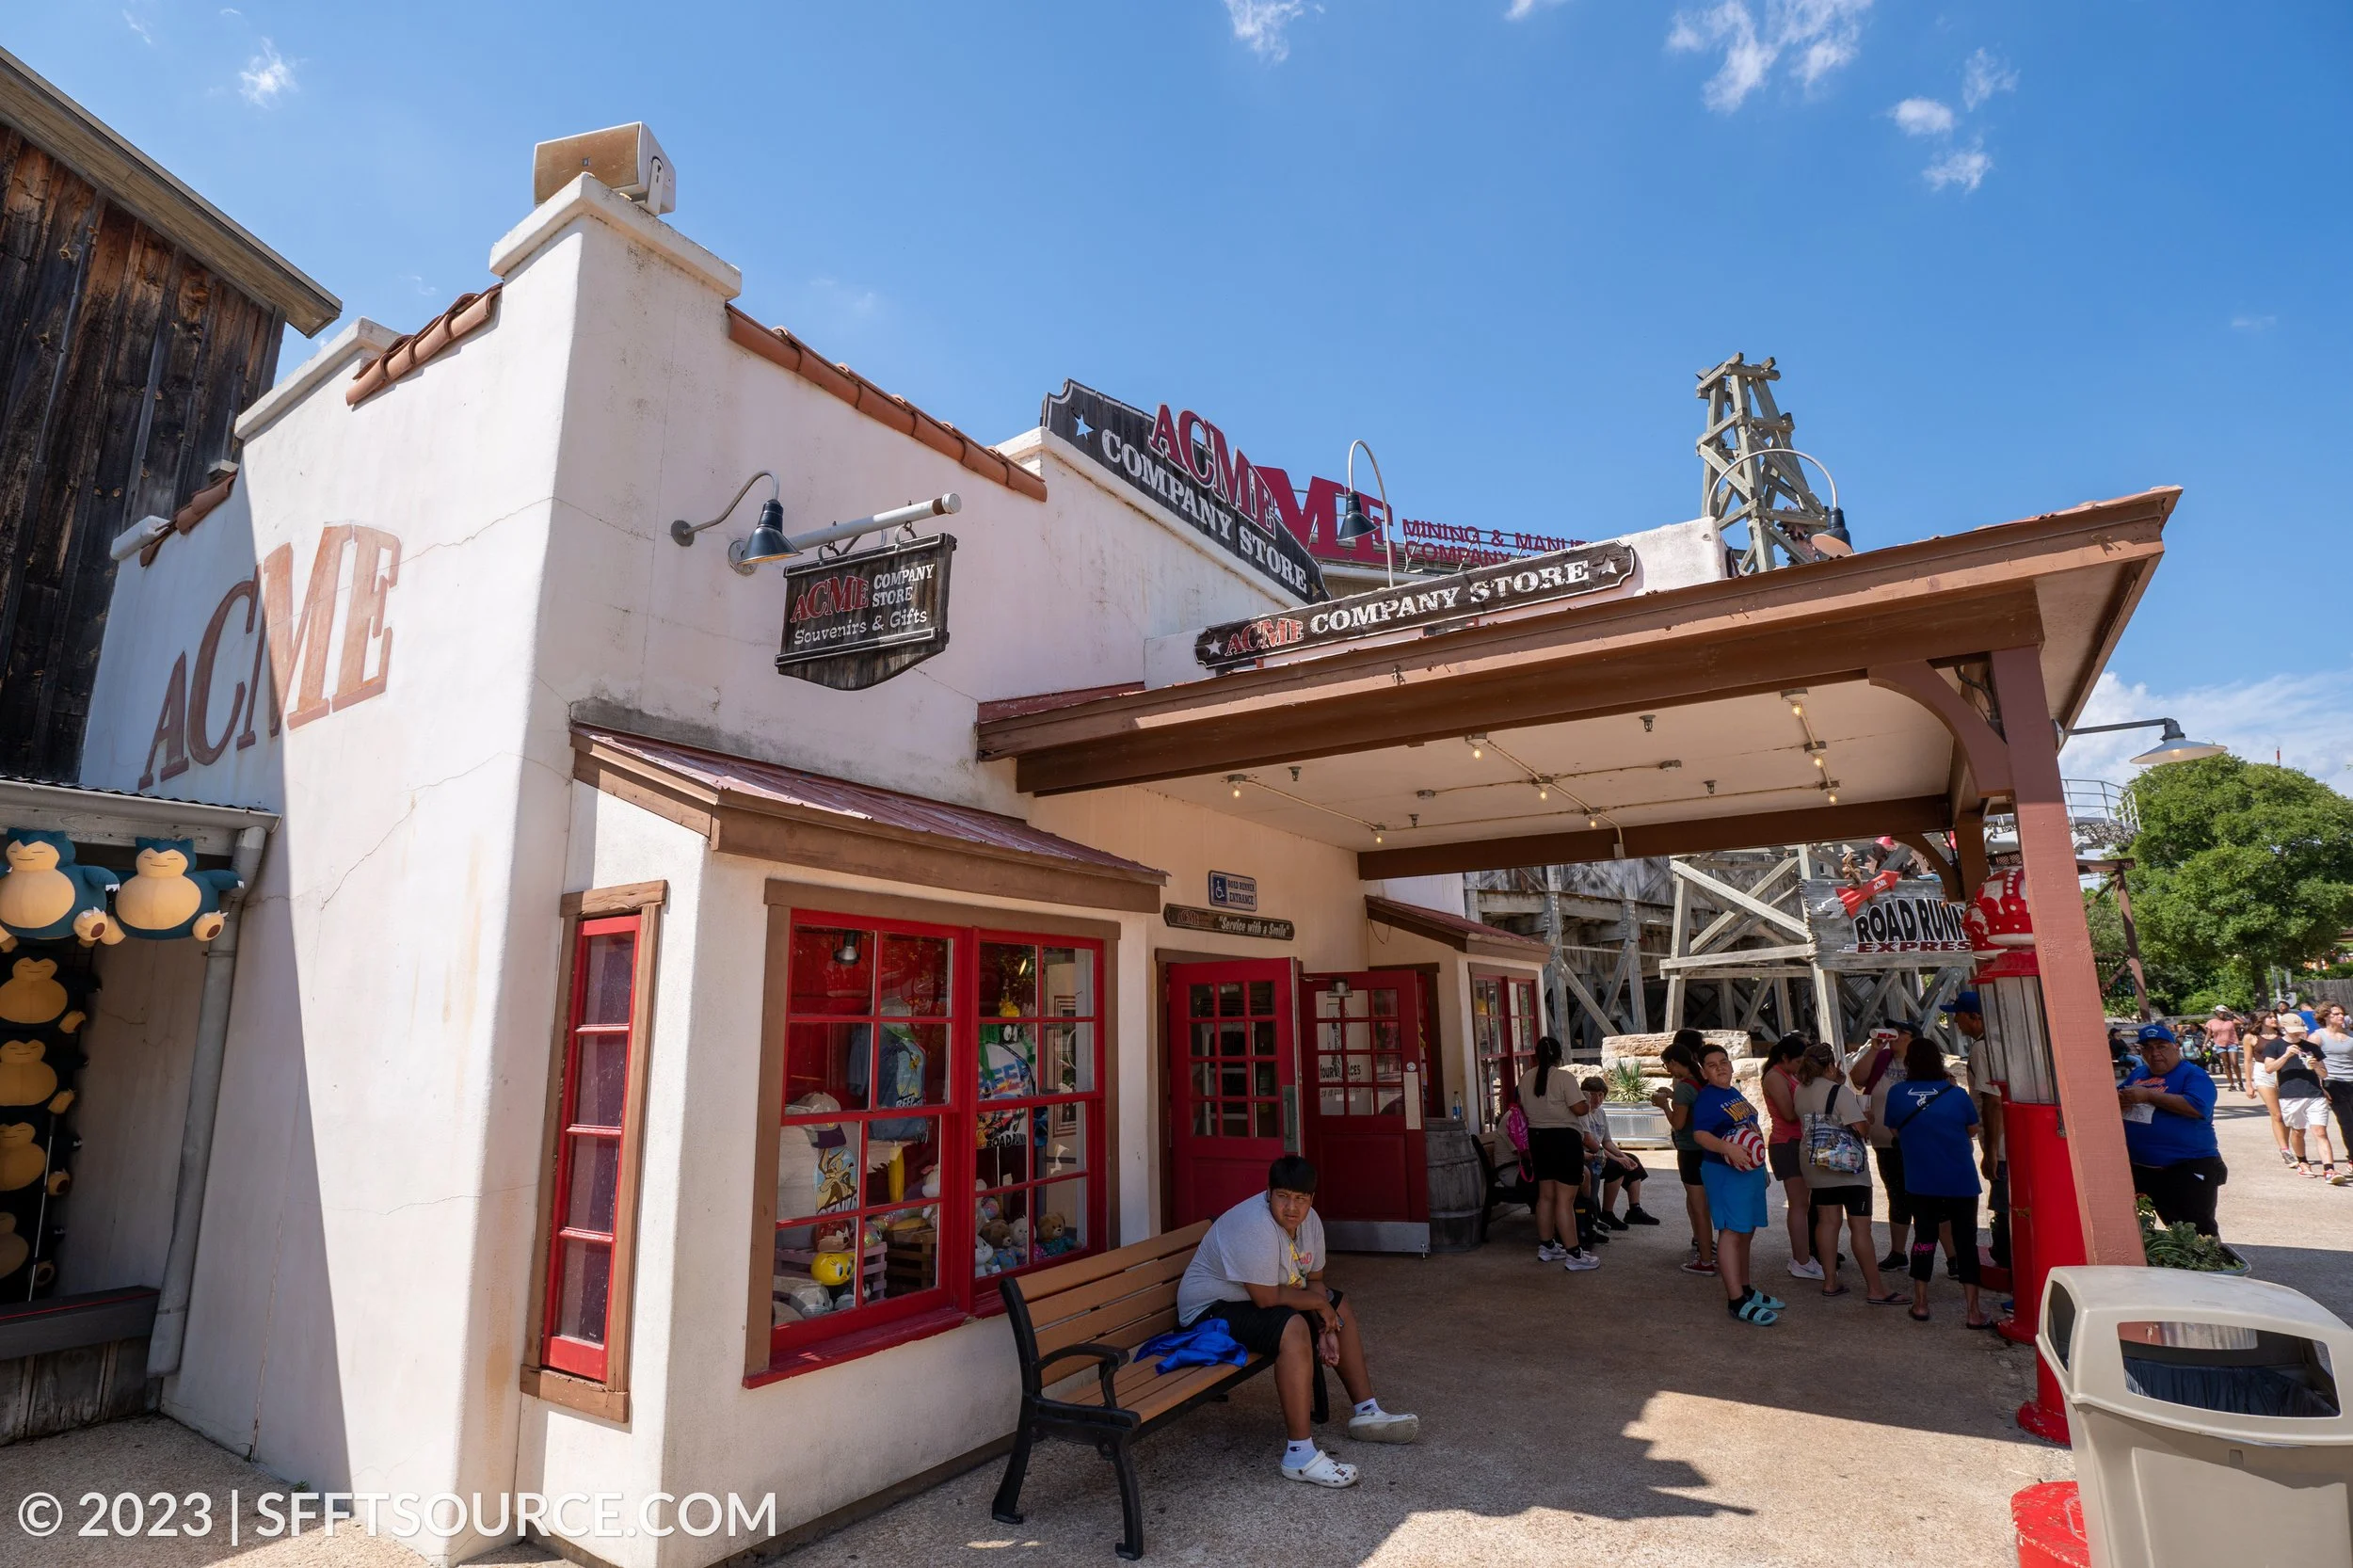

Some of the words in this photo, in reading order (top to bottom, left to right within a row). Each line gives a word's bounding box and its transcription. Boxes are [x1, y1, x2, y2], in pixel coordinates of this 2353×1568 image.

[1147, 402, 1277, 539] ACME
[1101, 428, 1233, 541] COMPANY
[1240, 528, 1308, 594] STORE
[1401, 519, 1480, 544] MINING
[1491, 529, 1505, 547] &
[1405, 540, 1511, 567] COMPANY
[873, 564, 935, 590] COMPANY
[791, 576, 870, 623] ACME
[872, 587, 913, 608] STORE
[1224, 616, 1305, 658] ACME
[1309, 586, 1459, 636] COMPANY
[1469, 559, 1592, 603] STORE
[793, 620, 867, 645] Souvenirs
[872, 616, 885, 631] &
[889, 609, 928, 629] Gifts
[138, 523, 401, 789] ACME
[1228, 892, 1255, 905] ENTRANCE
[1873, 879, 1887, 891] ACME
[1219, 916, 1246, 932] "Service
[1247, 920, 1261, 935] with
[1853, 898, 1918, 942] ROAD
[1914, 898, 1971, 942] RUNN
[1857, 941, 1972, 953] EXPRES
